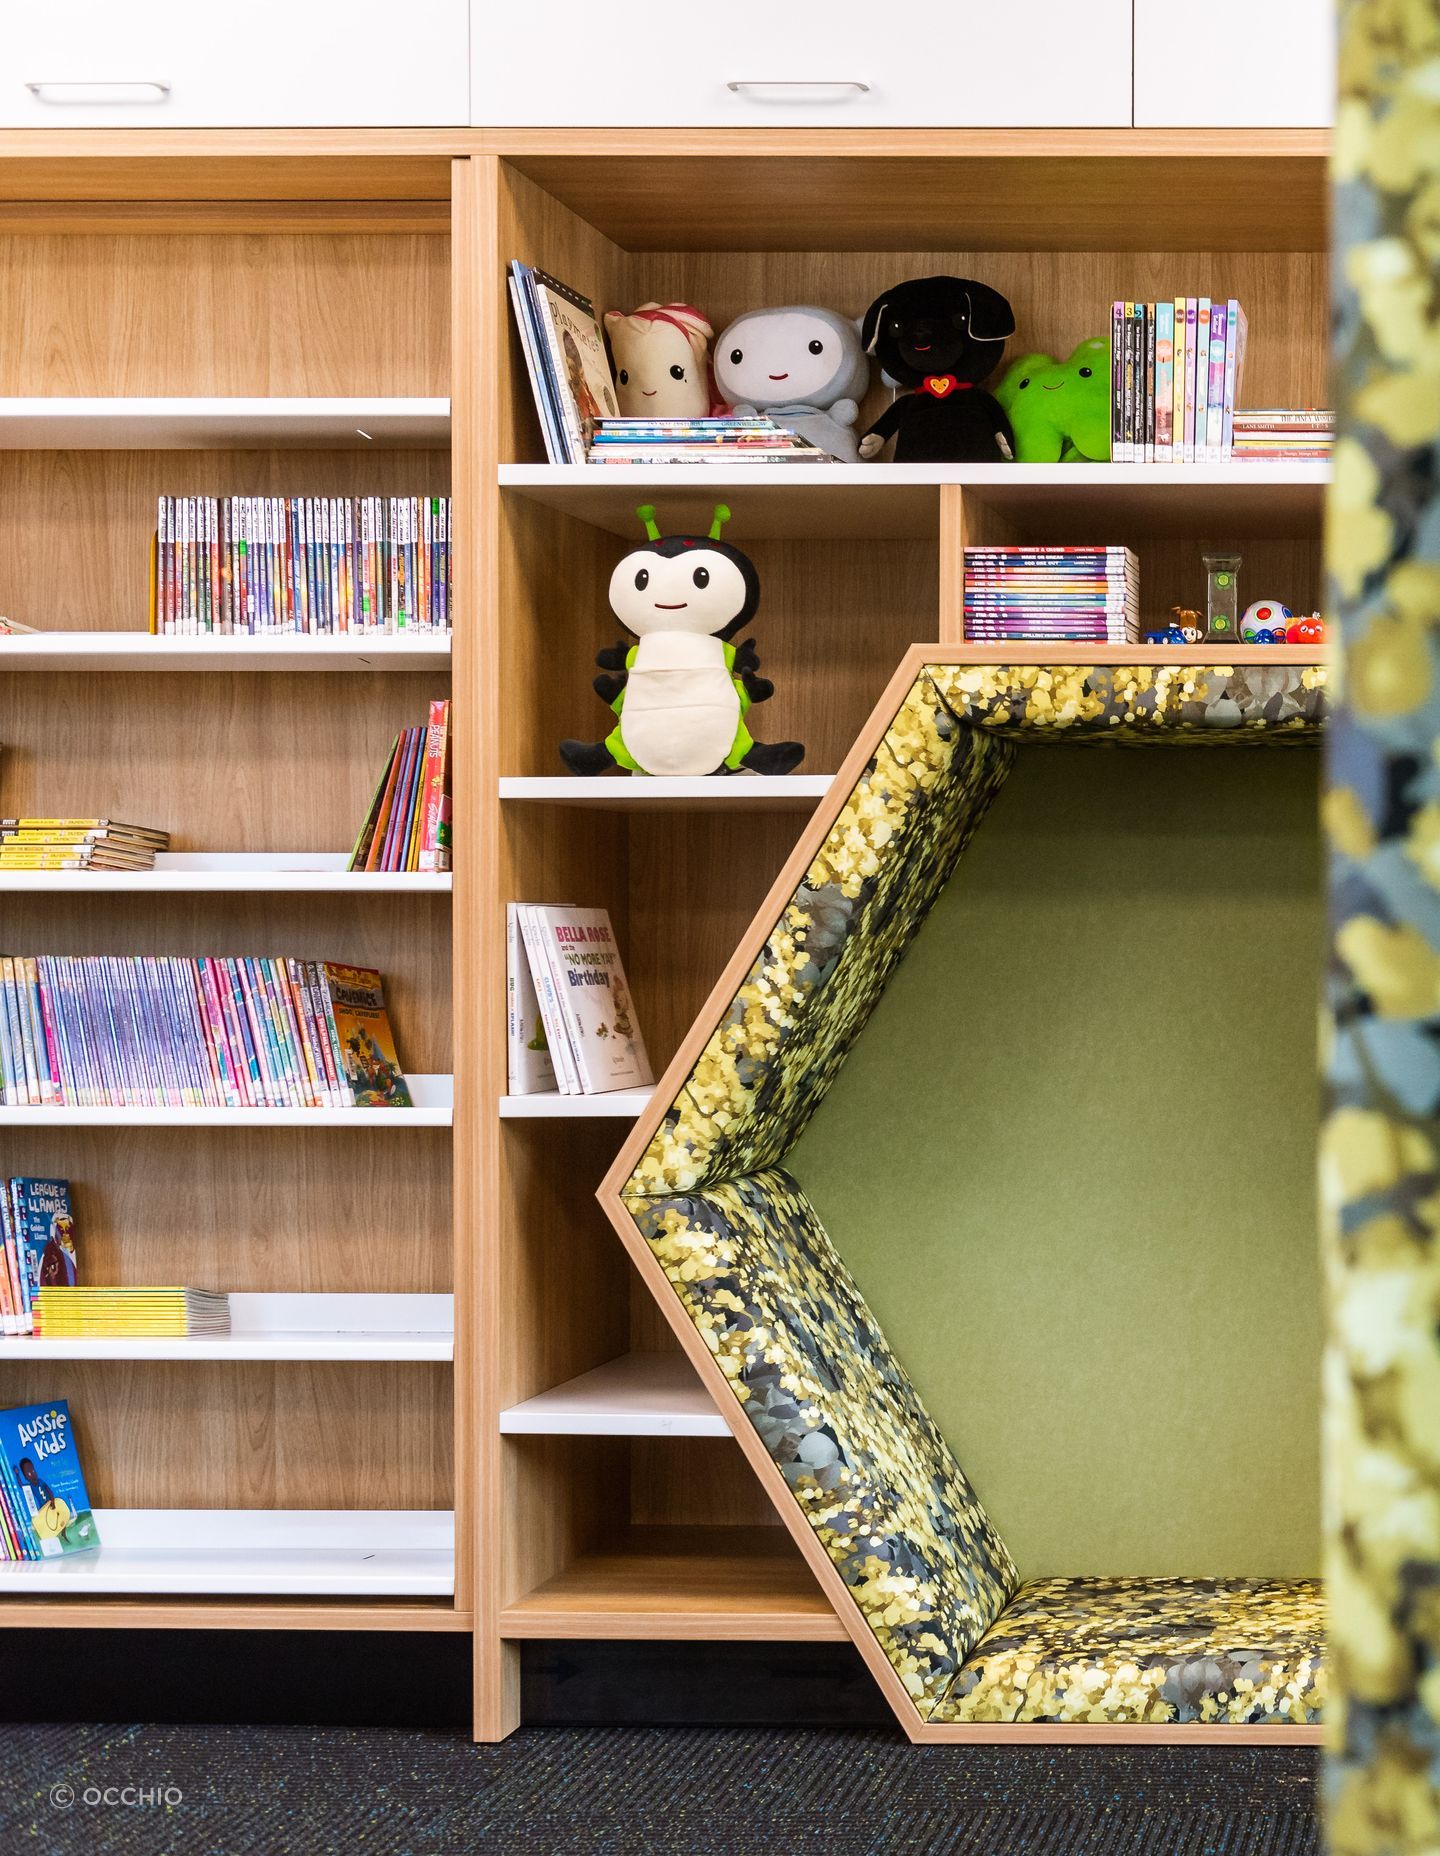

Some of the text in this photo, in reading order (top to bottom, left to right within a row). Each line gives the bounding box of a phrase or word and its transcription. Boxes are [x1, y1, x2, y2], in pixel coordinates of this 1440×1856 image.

[428, 724, 441, 758] PEANUTS
[555, 926, 585, 942] BELLA
[587, 926, 611, 942] ROSE
[582, 954, 600, 965] MORE
[568, 969, 609, 988] Birthday
[29, 1182, 59, 1198] LEAGUE
[28, 1198, 68, 1214] LLAMAS
[17, 1409, 67, 1448] Aussie
[33, 1432, 67, 1461] Kids
